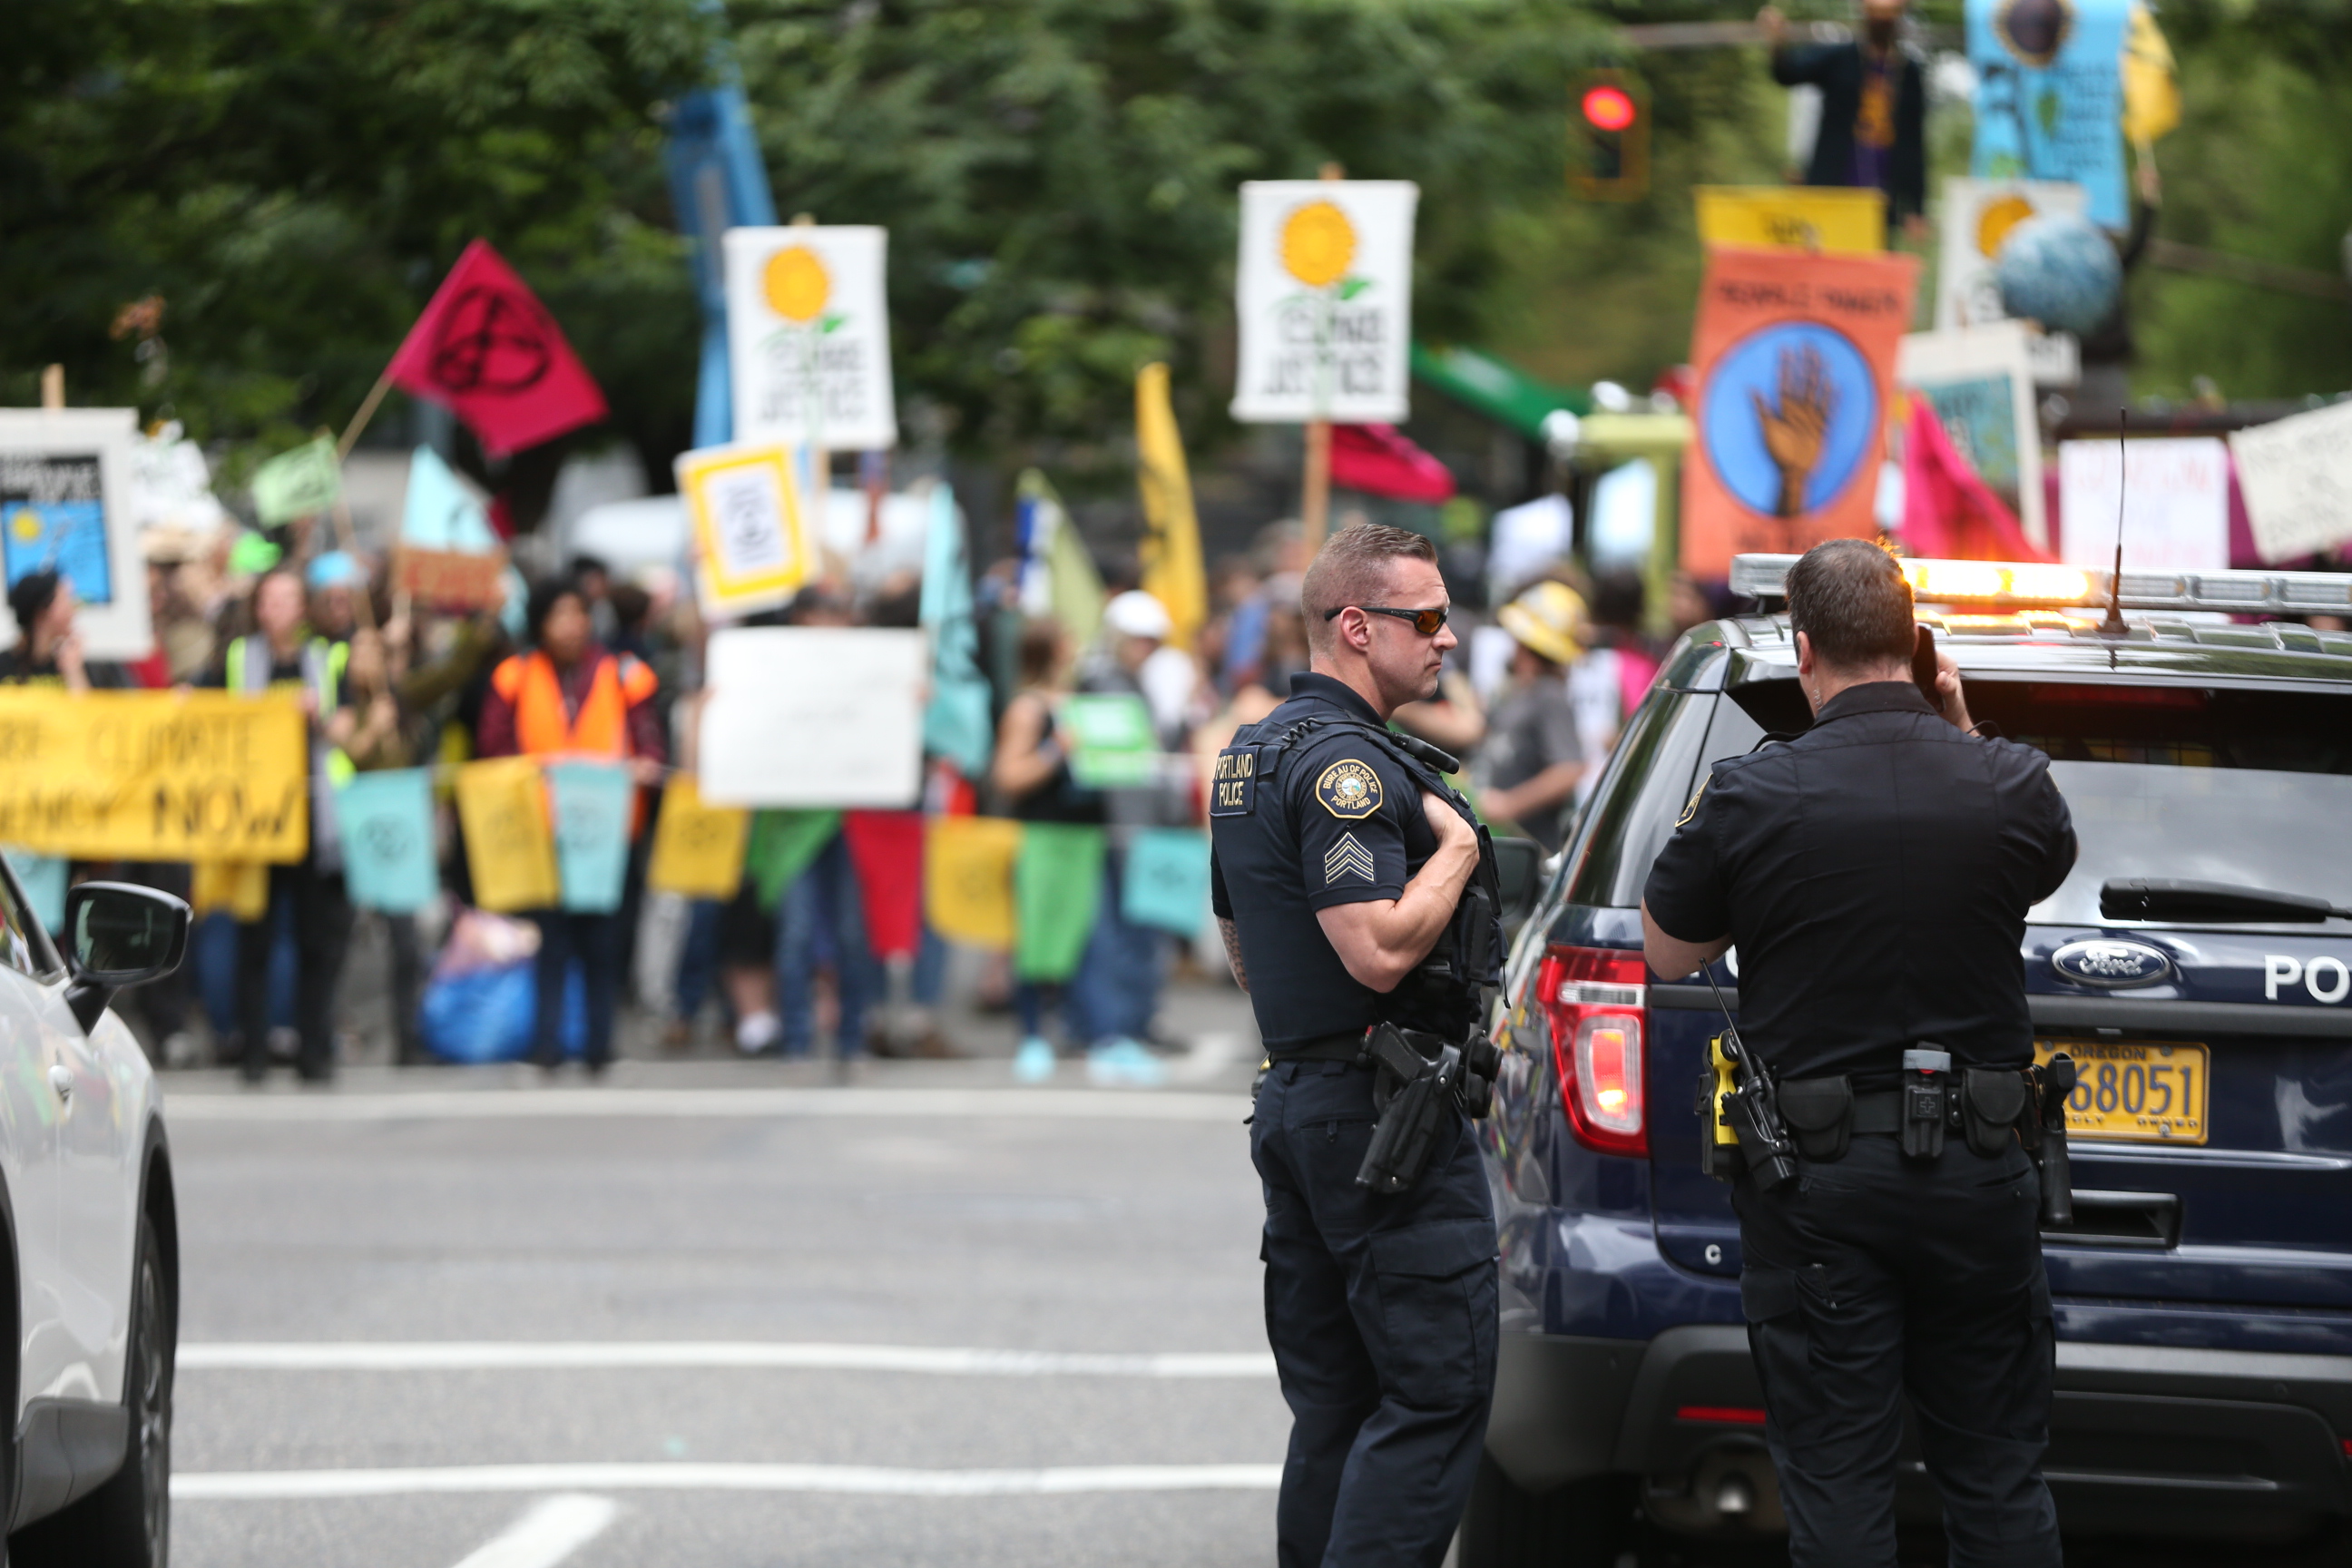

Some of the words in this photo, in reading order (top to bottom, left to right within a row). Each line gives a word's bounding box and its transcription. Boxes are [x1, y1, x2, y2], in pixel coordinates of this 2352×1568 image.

[1215, 753, 1253, 780] PORTLAND
[1322, 764, 1349, 789] BUREAU
[1349, 764, 1361, 773] OF
[1359, 768, 1378, 794] POLICE
[151, 774, 299, 841] NOW
[1219, 780, 1244, 807] POLICE
[1330, 795, 1371, 810] PORTLAND
[2079, 946, 2144, 976] Ford
[2264, 954, 2351, 1004] PO
[2070, 1044, 2147, 1061] OREGON
[2069, 1061, 2192, 1116] 68051
